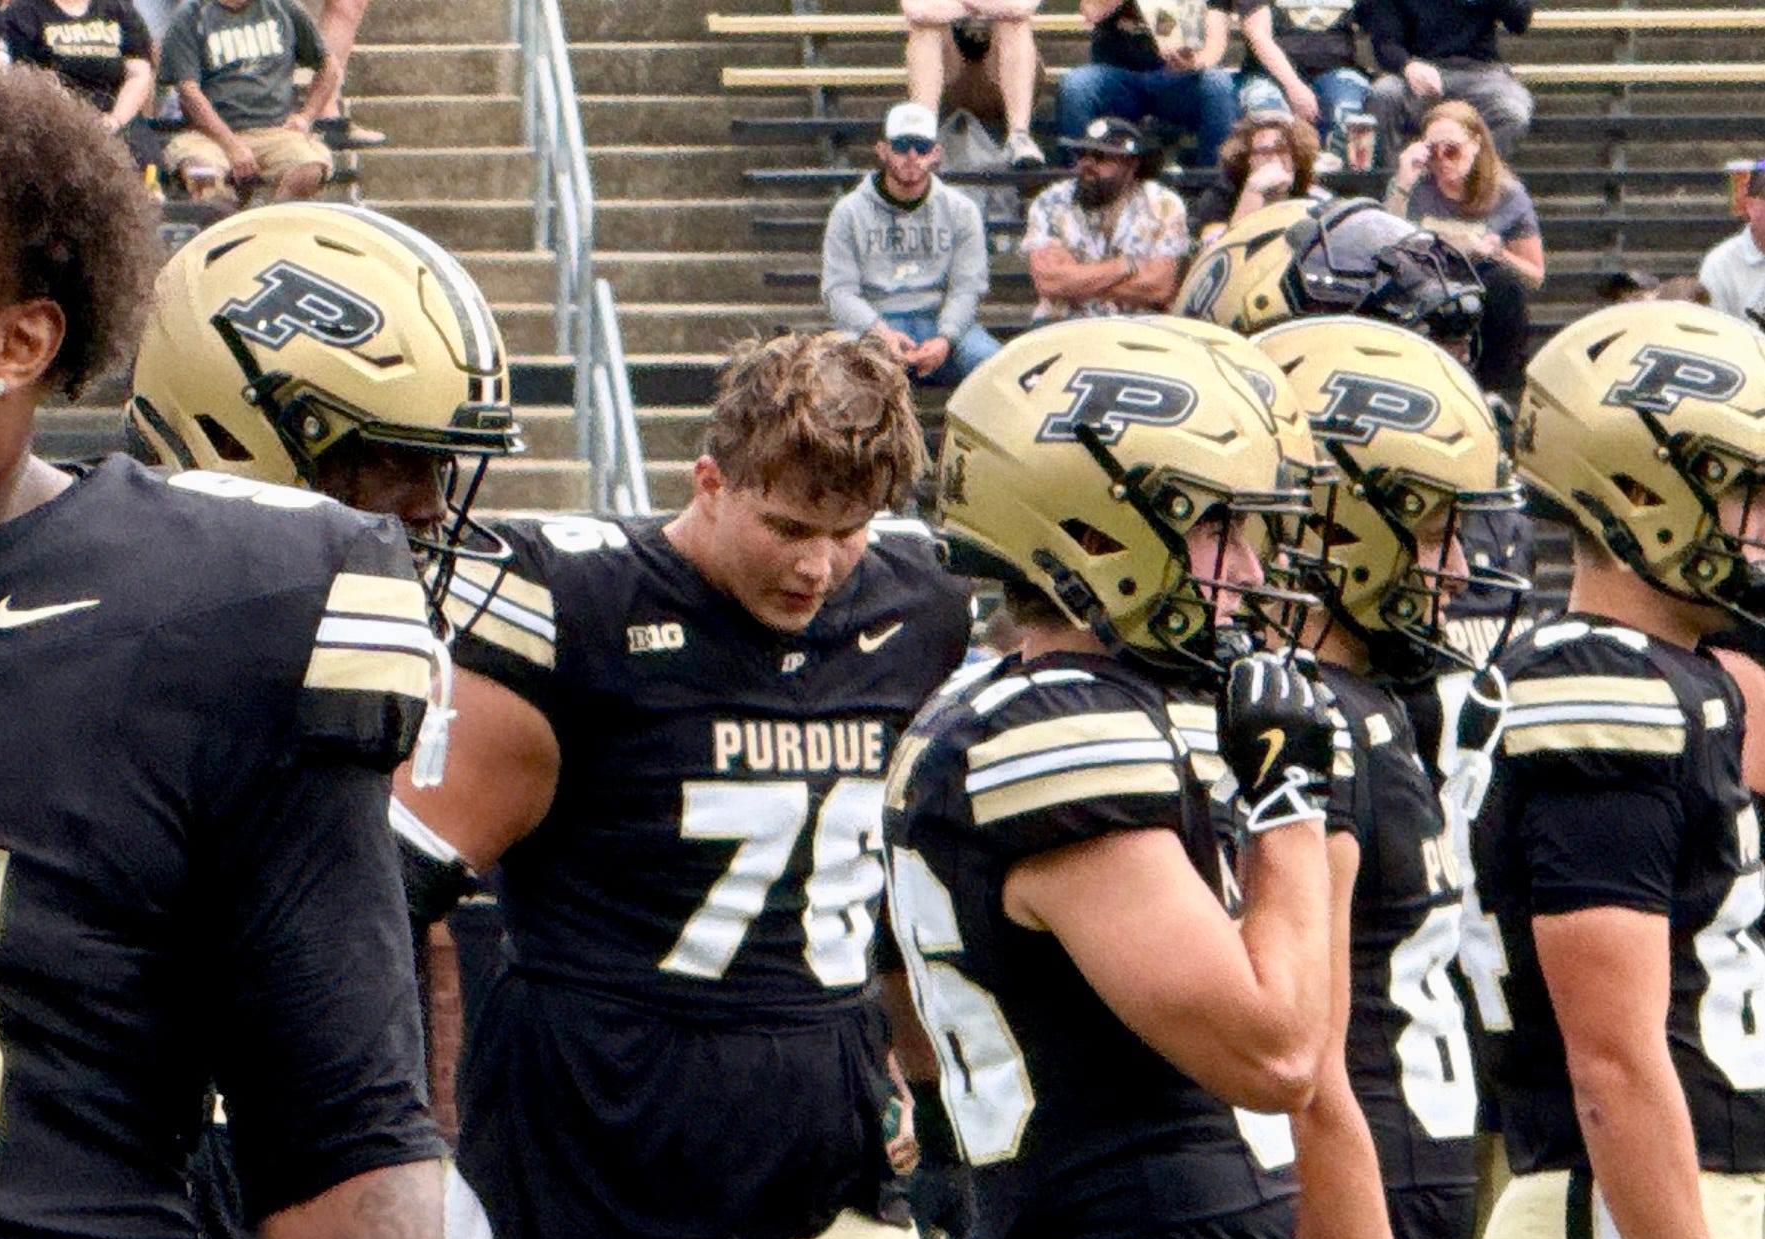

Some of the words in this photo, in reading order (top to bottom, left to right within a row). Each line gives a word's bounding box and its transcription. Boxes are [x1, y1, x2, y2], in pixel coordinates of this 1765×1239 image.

[210, 259, 385, 351] P
[1033, 366, 1199, 446] P
[1305, 369, 1441, 447] P
[1600, 344, 1747, 415] P
[713, 720, 885, 773] PURDUE
